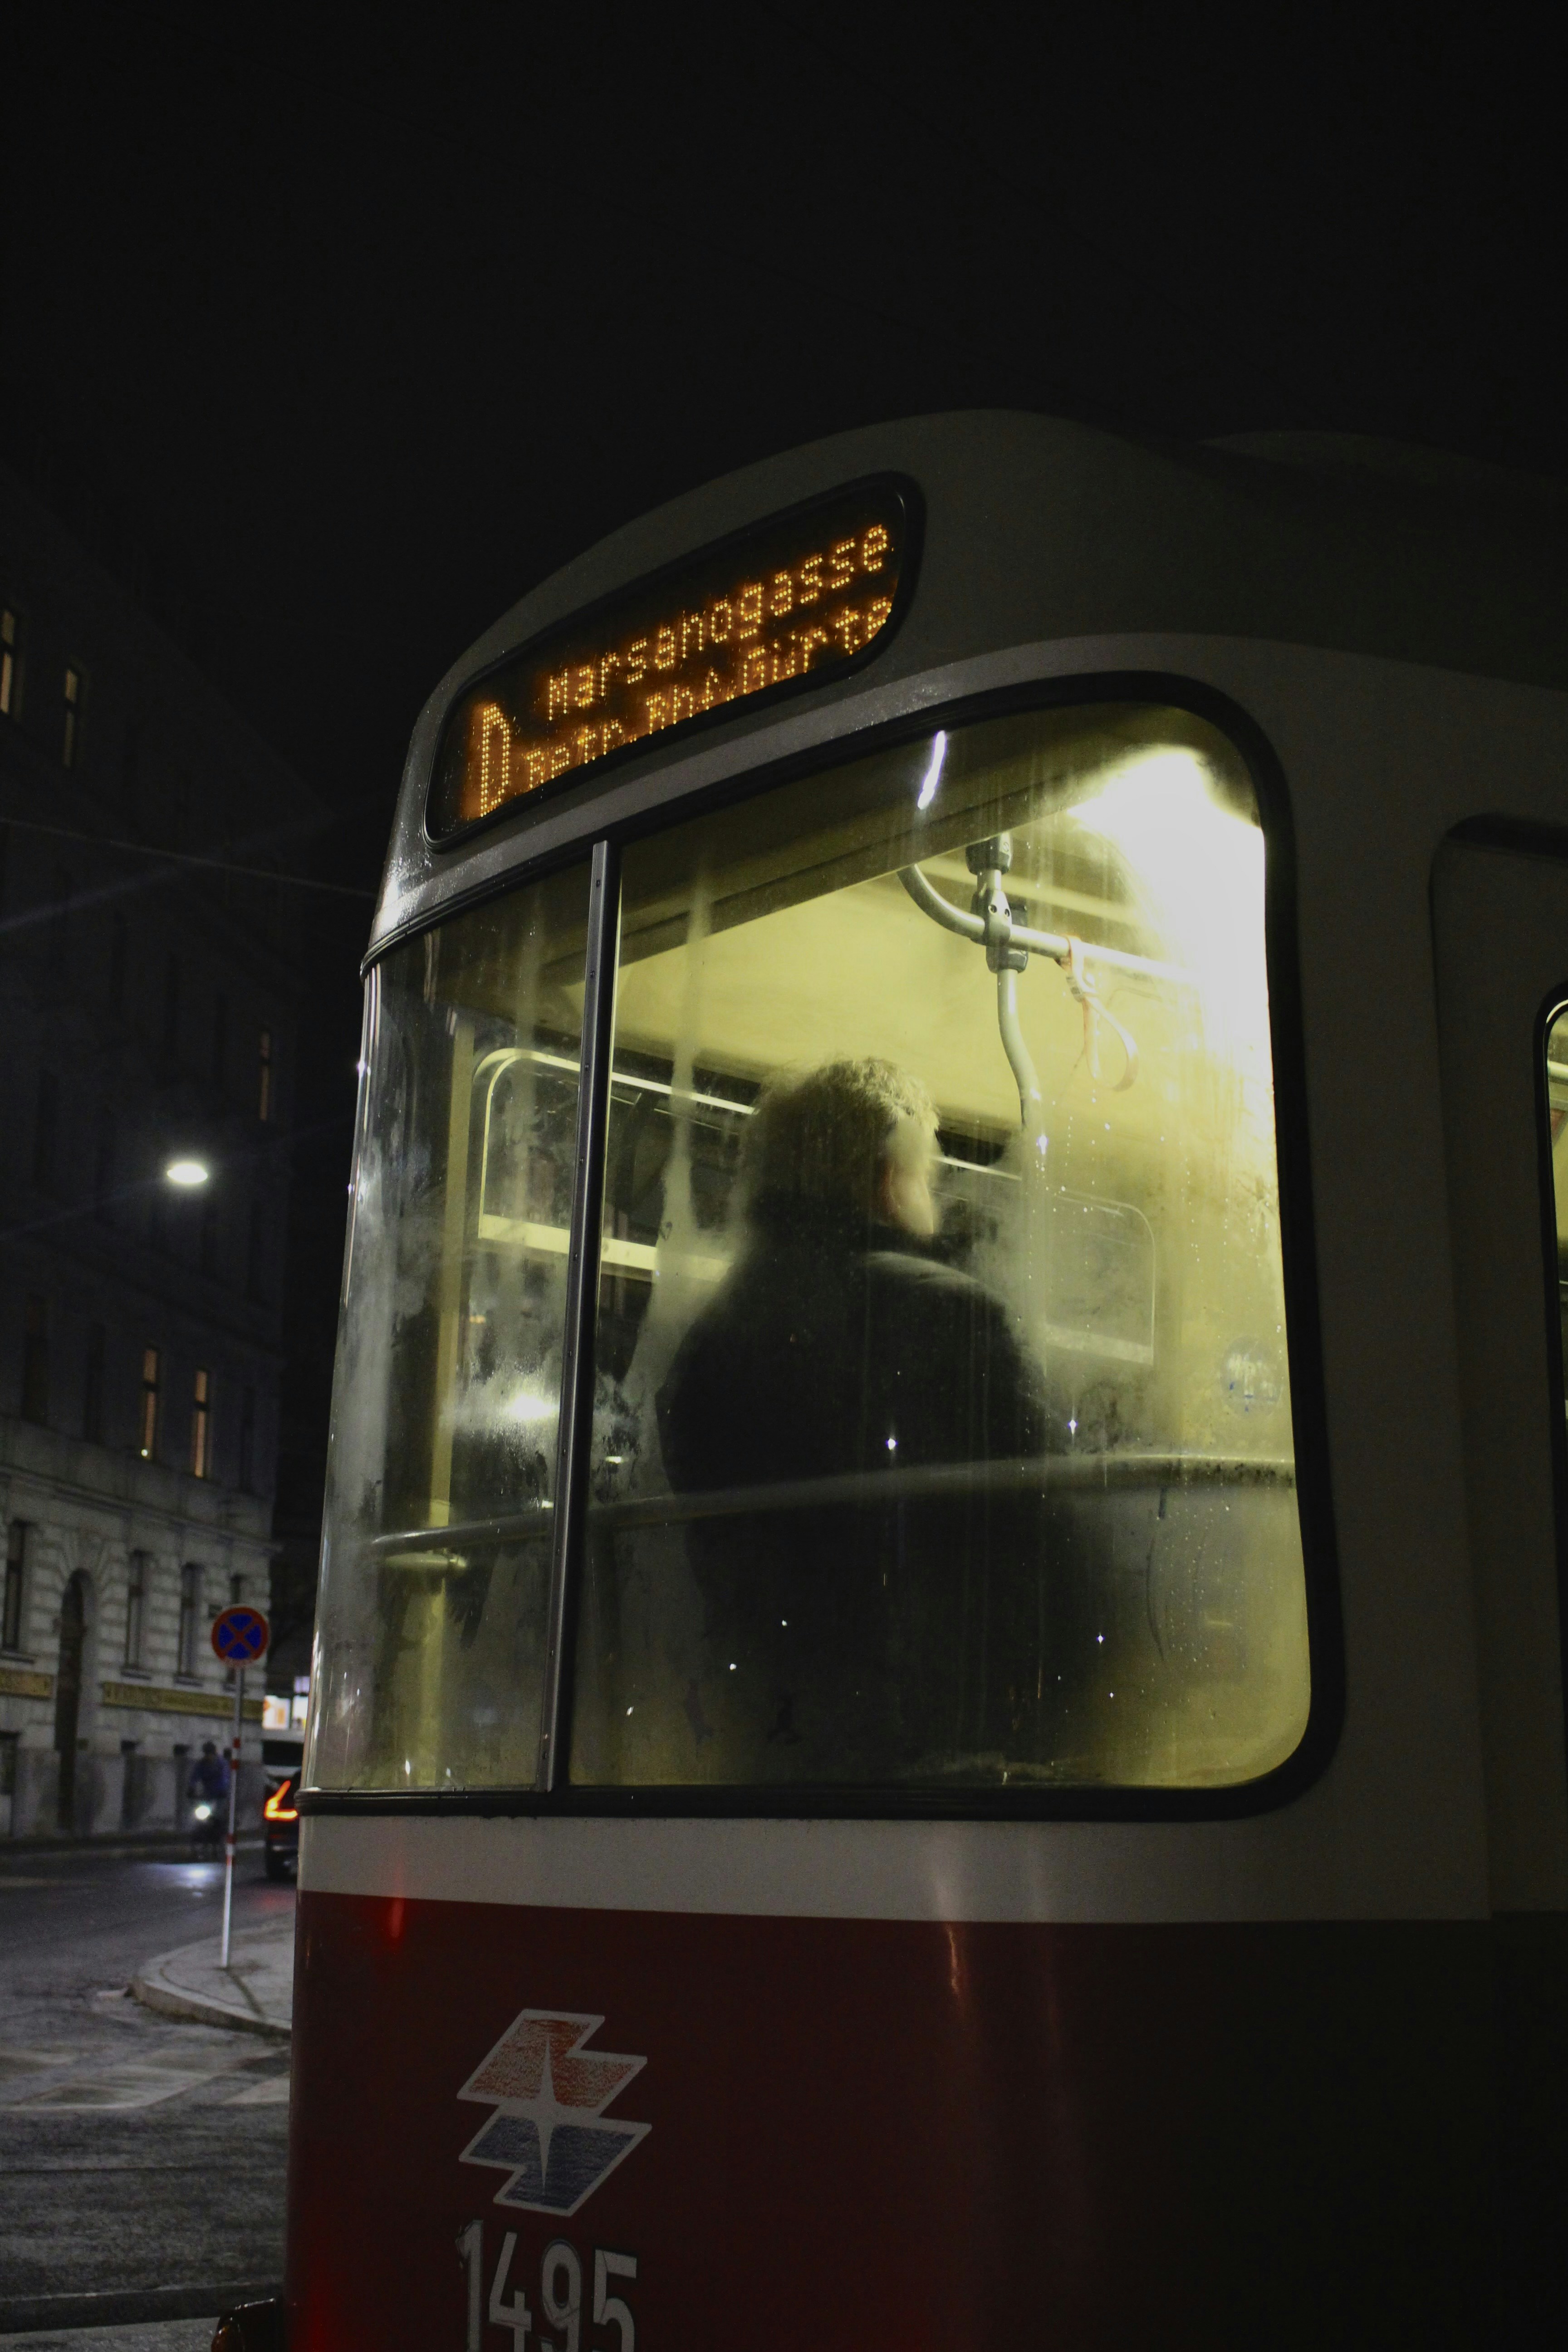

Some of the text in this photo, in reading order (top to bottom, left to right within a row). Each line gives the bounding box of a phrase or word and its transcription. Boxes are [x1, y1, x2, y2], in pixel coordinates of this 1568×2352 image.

[549, 524, 888, 721] Marsanogasse
[479, 704, 511, 818] D
[455, 2220, 637, 2352] 1495
